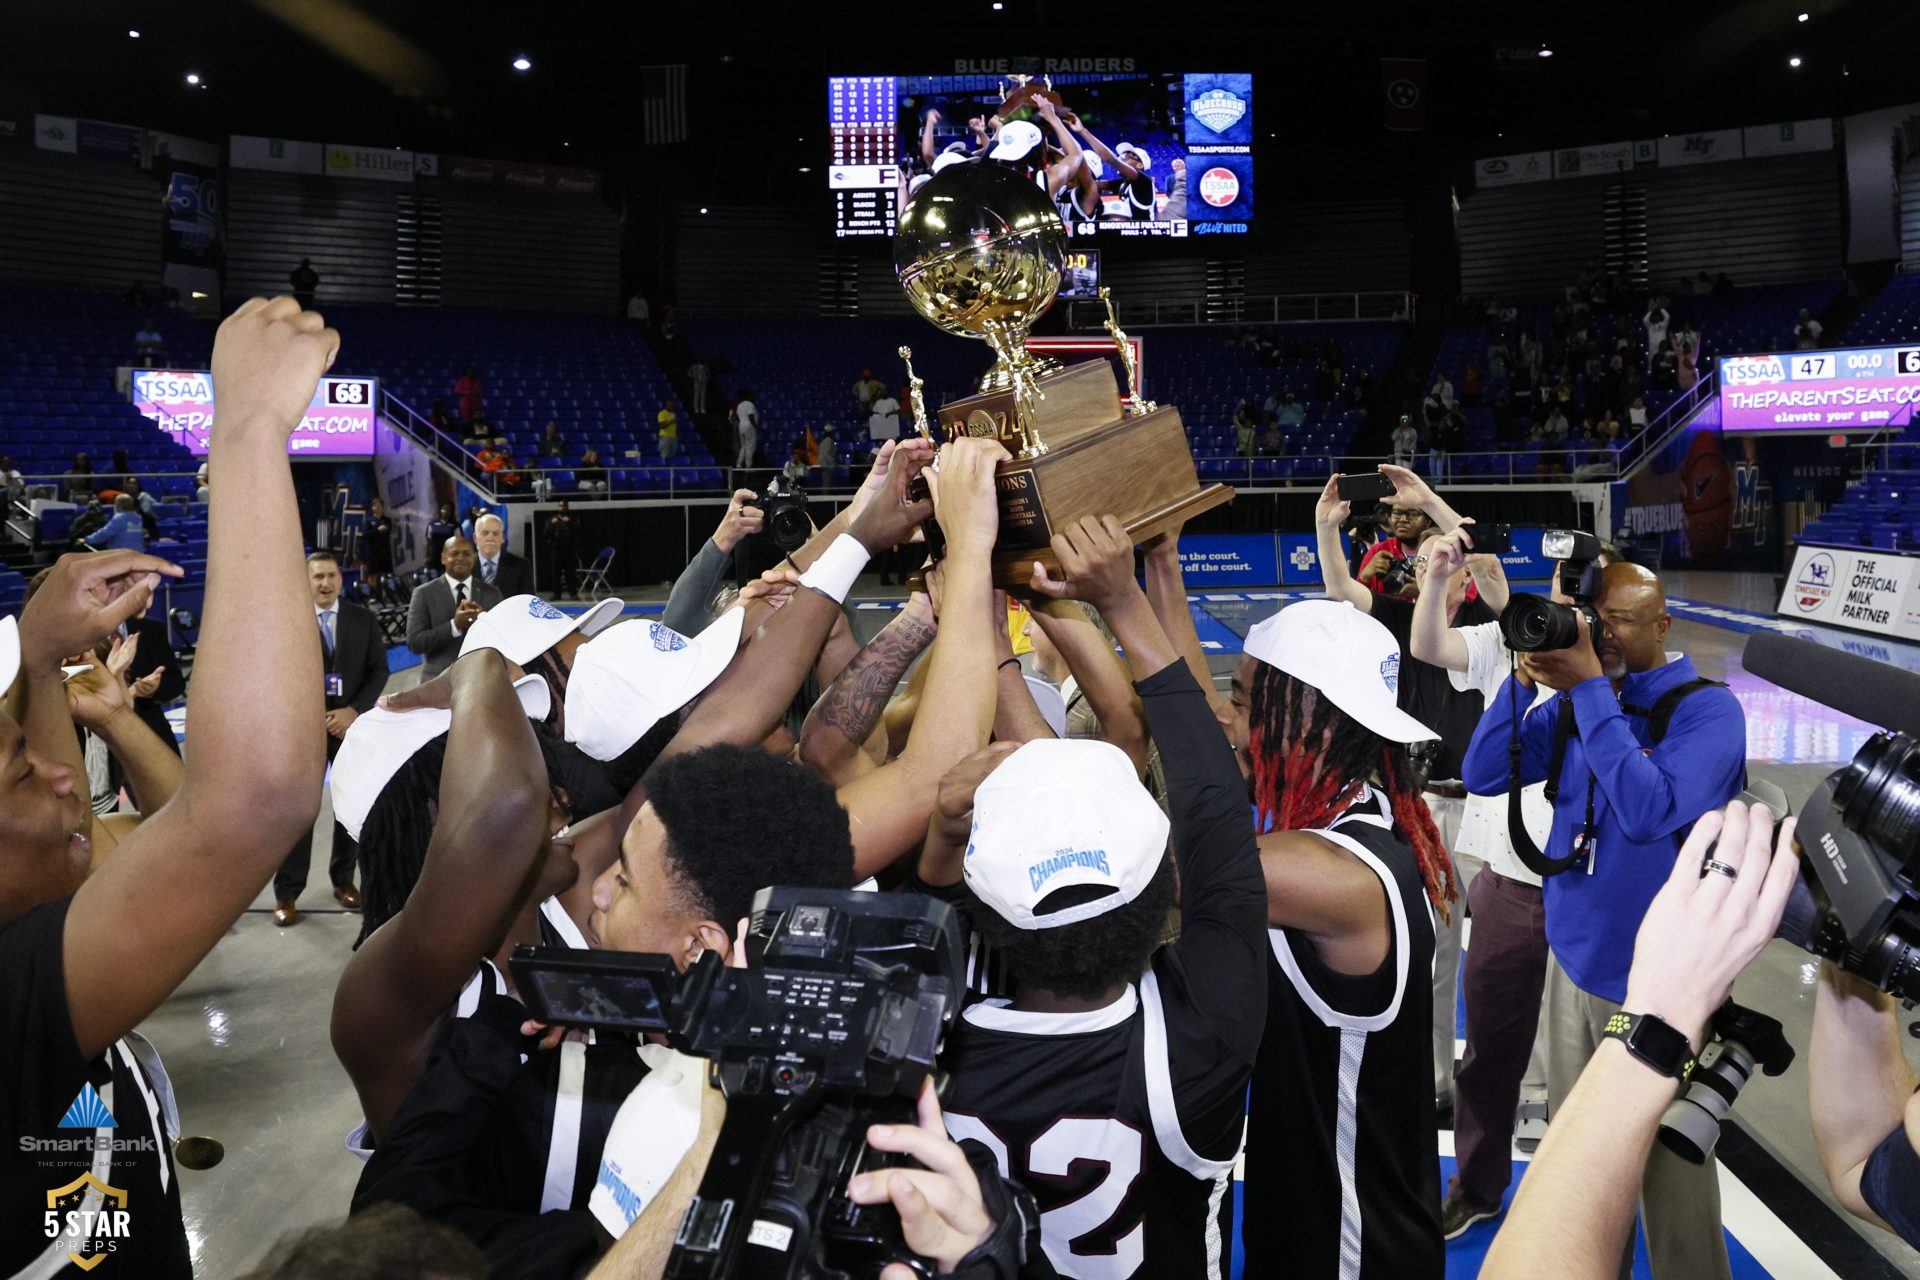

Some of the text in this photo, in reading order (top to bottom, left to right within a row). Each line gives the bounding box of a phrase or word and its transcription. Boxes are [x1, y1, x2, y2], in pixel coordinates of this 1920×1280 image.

[954, 58, 1008, 73] BLUE
[1045, 57, 1136, 73] RAIDERS
[1194, 98, 1243, 112] BLUECROSS
[354, 151, 411, 174] Hiller
[420, 154, 432, 172] S
[1204, 181, 1236, 190] TSSAA
[1077, 222, 1096, 236] 68
[1099, 222, 1140, 230] KNOXVILLE
[1726, 362, 1782, 380] TSSAA
[1801, 358, 1825, 376] 47
[1848, 353, 1882, 369] 00.0
[141, 380, 363, 403] TSSAA 68
[1775, 410, 1890, 423] elevate your game
[291, 437, 320, 450] game
[1189, 552, 1206, 560] the
[1208, 552, 1240, 560] court.
[1502, 556, 1532, 564] court.
[1184, 563, 1200, 572] off
[1201, 563, 1218, 571] the
[1220, 562, 1252, 571] court.
[1856, 560, 1876, 574] THE
[1852, 575, 1898, 593] OFFICIAL
[1846, 590, 1874, 606] MILK
[1841, 604, 1890, 624] PARTNER
[1820, 832, 1839, 859] HD
[1029, 849, 1111, 893] CHAMPIONS
